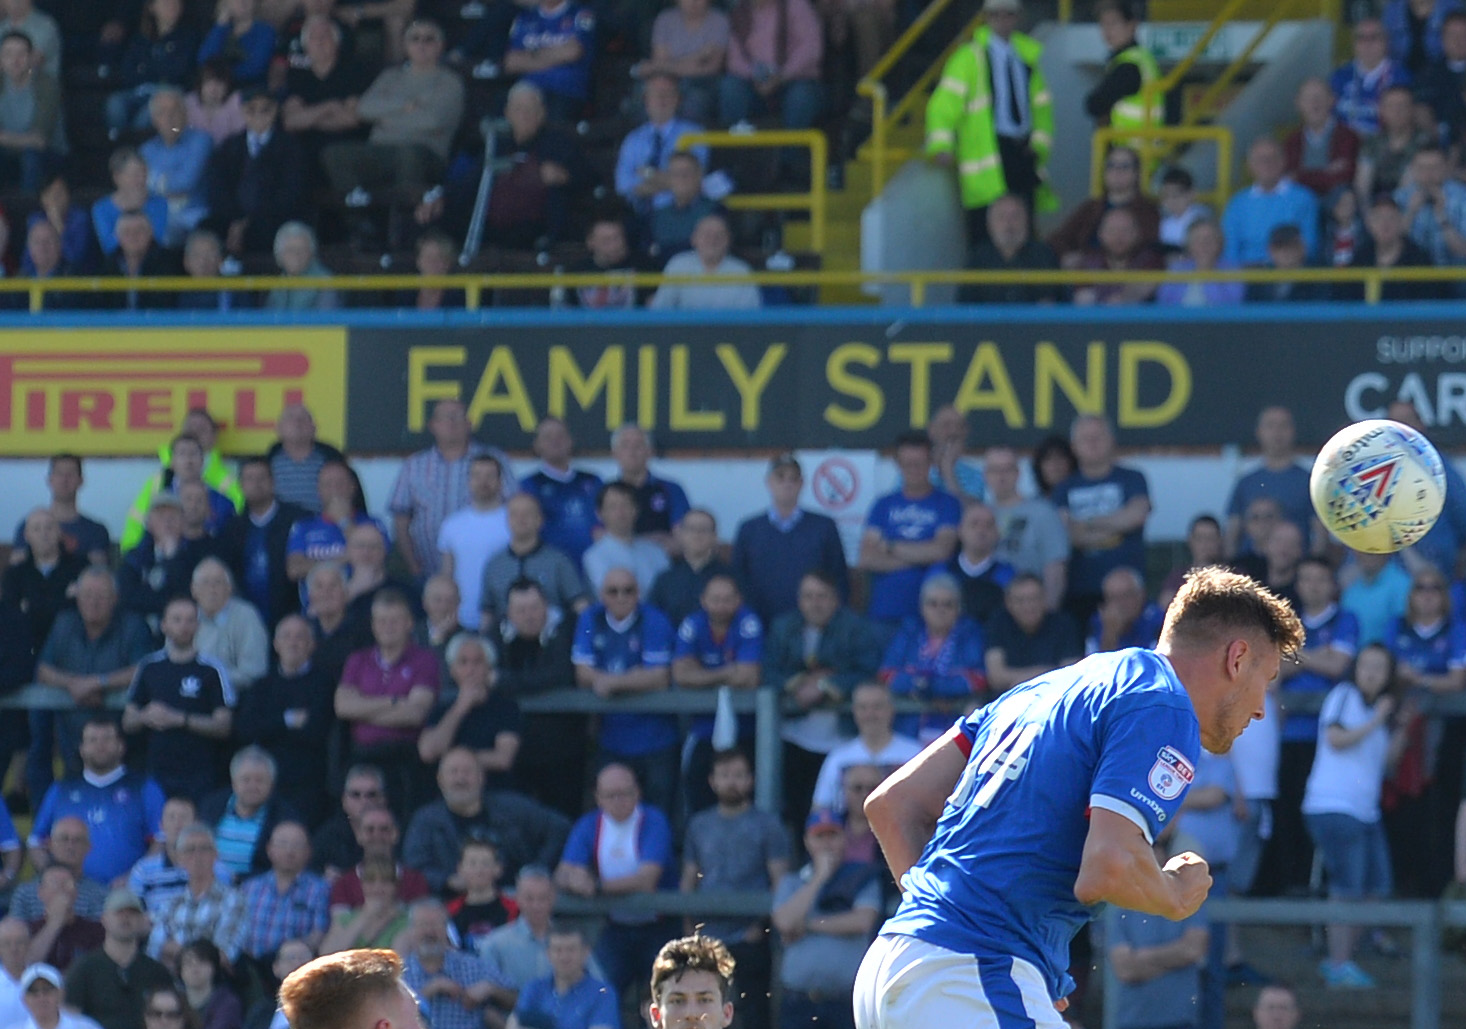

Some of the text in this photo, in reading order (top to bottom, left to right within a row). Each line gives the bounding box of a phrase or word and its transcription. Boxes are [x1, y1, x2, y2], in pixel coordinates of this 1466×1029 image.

[406, 341, 1192, 432] FAMILY STAND
[1130, 787, 1167, 822] umbro
